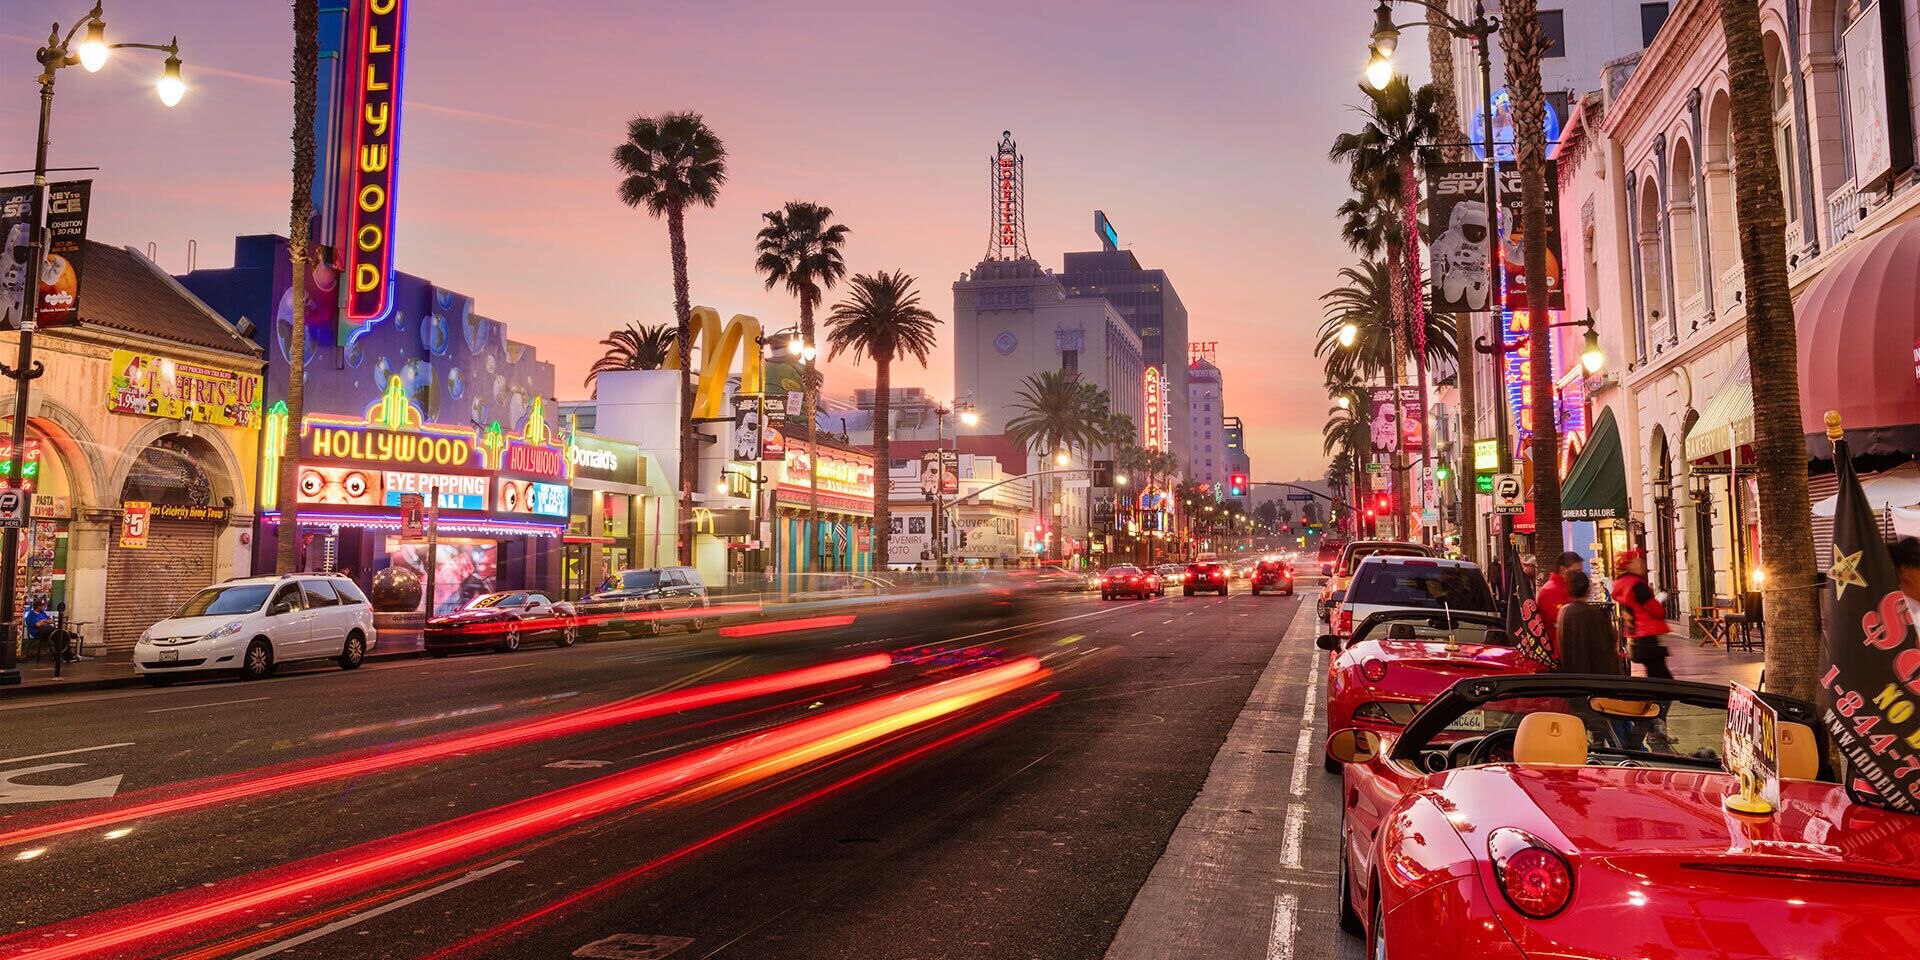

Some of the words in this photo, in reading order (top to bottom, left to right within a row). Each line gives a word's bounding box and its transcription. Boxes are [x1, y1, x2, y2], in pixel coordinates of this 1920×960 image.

[1436, 180, 1550, 195] SPAC
[2, 199, 82, 219] SPCE
[51, 220, 83, 229] EXHIBITION
[1147, 384, 1159, 448] CAPITA
[313, 428, 468, 466] HOLLYWOOD
[1685, 430, 1716, 461] BAKERY
[511, 446, 560, 476] HOLLYWOOD
[386, 472, 416, 491] EYE
[418, 473, 485, 494] POPPING
[36, 495, 53, 505] PASTA
[423, 493, 464, 510] EAL!
[161, 504, 189, 518] Celebrity
[1562, 510, 1588, 518] CAMERAS
[1588, 508, 1616, 517] GALORE
[124, 513, 144, 536] $5
[971, 531, 984, 540] OF
[1872, 682, 1915, 724] NO
